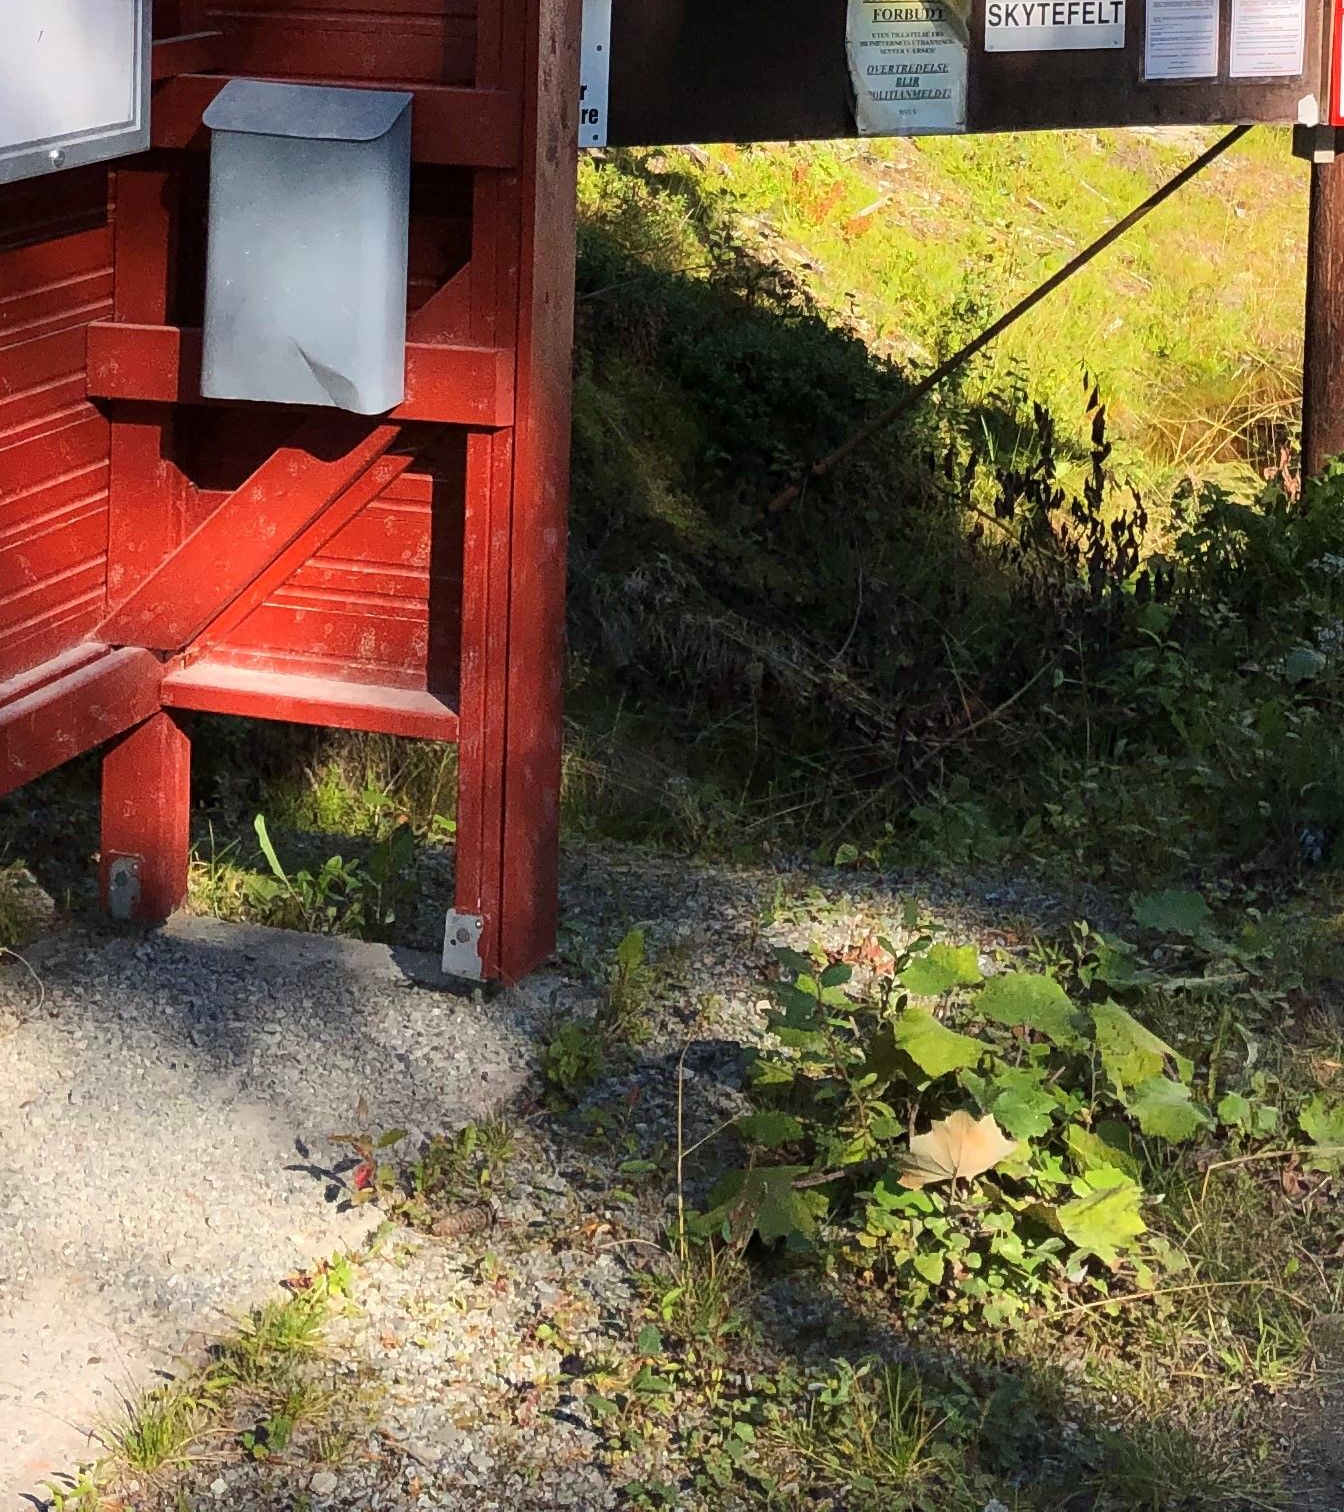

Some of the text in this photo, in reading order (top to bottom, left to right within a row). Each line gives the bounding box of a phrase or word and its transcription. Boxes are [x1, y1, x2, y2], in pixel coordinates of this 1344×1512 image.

[873, 7, 944, 22] FORBUDT
[987, 0, 1125, 28] SKYTEFELT
[896, 76, 919, 87] BLIR
